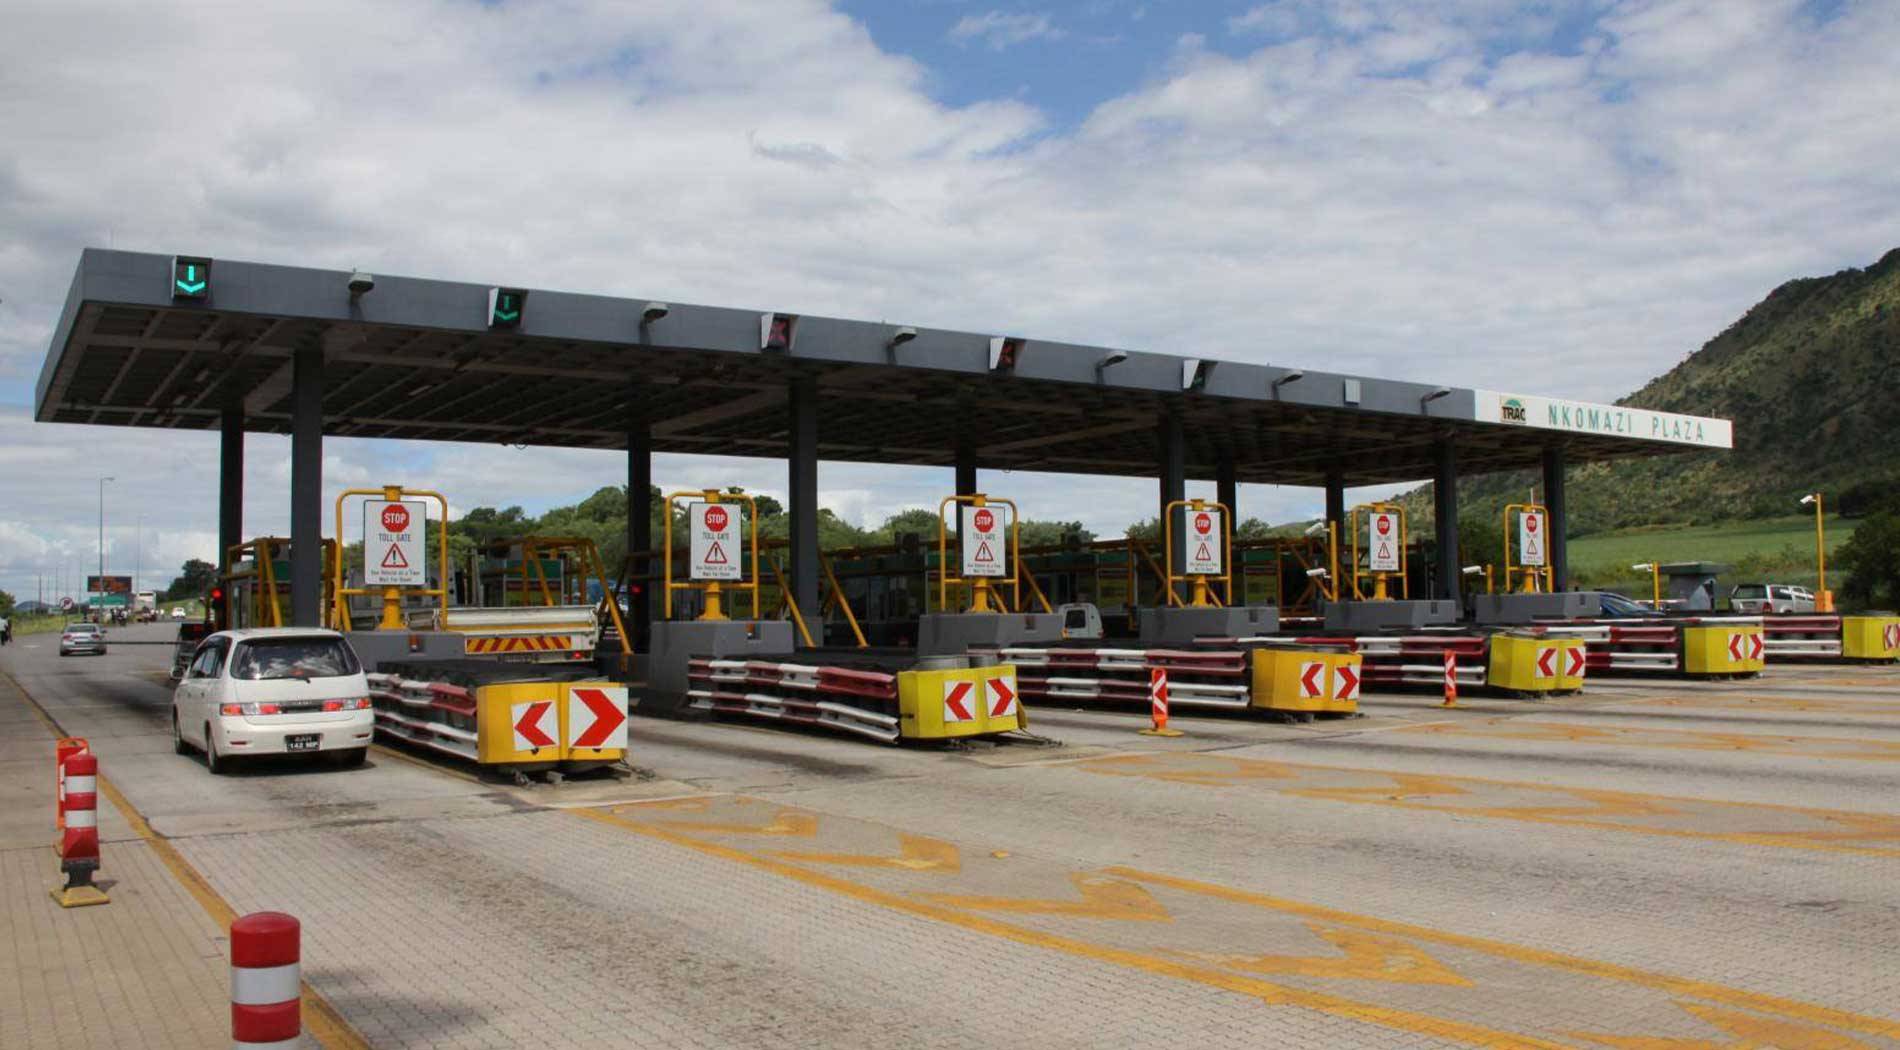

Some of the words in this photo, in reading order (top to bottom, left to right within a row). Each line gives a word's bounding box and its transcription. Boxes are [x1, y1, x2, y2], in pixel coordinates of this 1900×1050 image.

[1501, 405, 1526, 421] TRAC
[1548, 405, 1632, 433] NKOMAZI
[1652, 416, 1704, 441] PLAZA
[383, 513, 407, 525] STOP
[707, 514, 726, 524] STOP
[976, 516, 992, 525] STOP
[378, 533, 393, 543] TOLL
[396, 533, 412, 543] GATE
